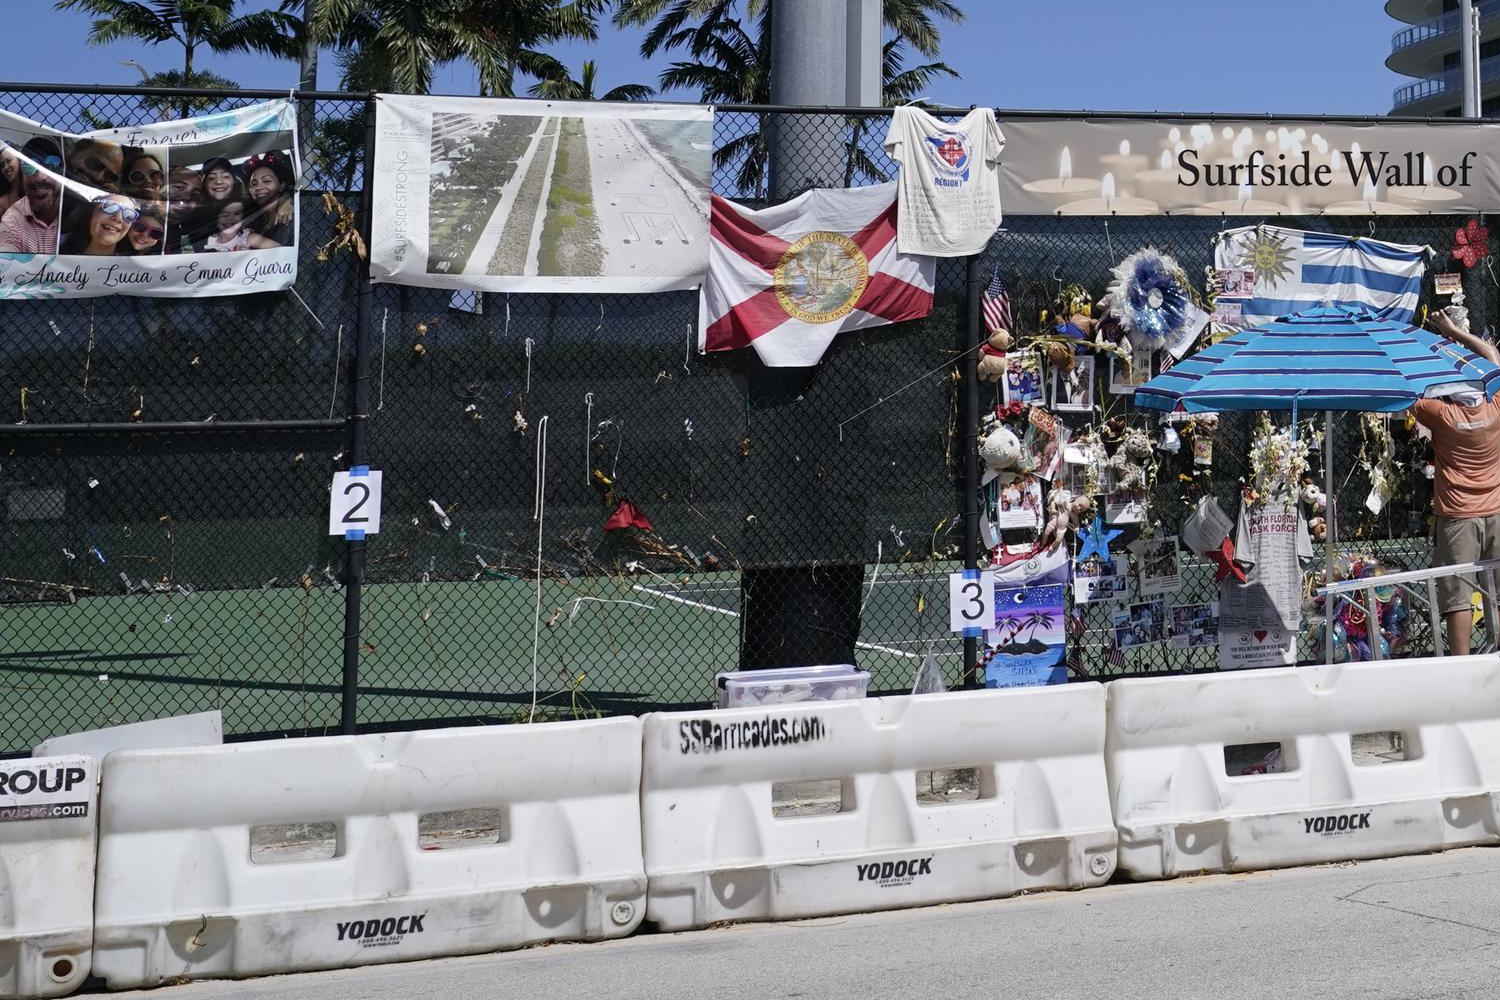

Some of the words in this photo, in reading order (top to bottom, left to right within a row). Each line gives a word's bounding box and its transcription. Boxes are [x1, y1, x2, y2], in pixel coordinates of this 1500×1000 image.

[1177, 149, 1333, 187] Surfside
[1342, 150, 1428, 187] Wall
[1437, 151, 1478, 187] of
[393, 150, 408, 262] #SURFSIDESTRONG
[16, 264, 90, 290] Anaely
[97, 264, 152, 287] Lucia
[159, 271, 168, 282] &
[176, 262, 235, 282] Emma
[244, 257, 294, 286] Guara
[341, 482, 370, 524] 2
[1270, 524, 1297, 534] FORCE
[961, 582, 985, 620] 3
[680, 715, 832, 755] SSBarricades.com
[1304, 813, 1371, 833] YODOCK
[857, 858, 932, 881] YODOCK
[337, 914, 426, 940] YODOCK
